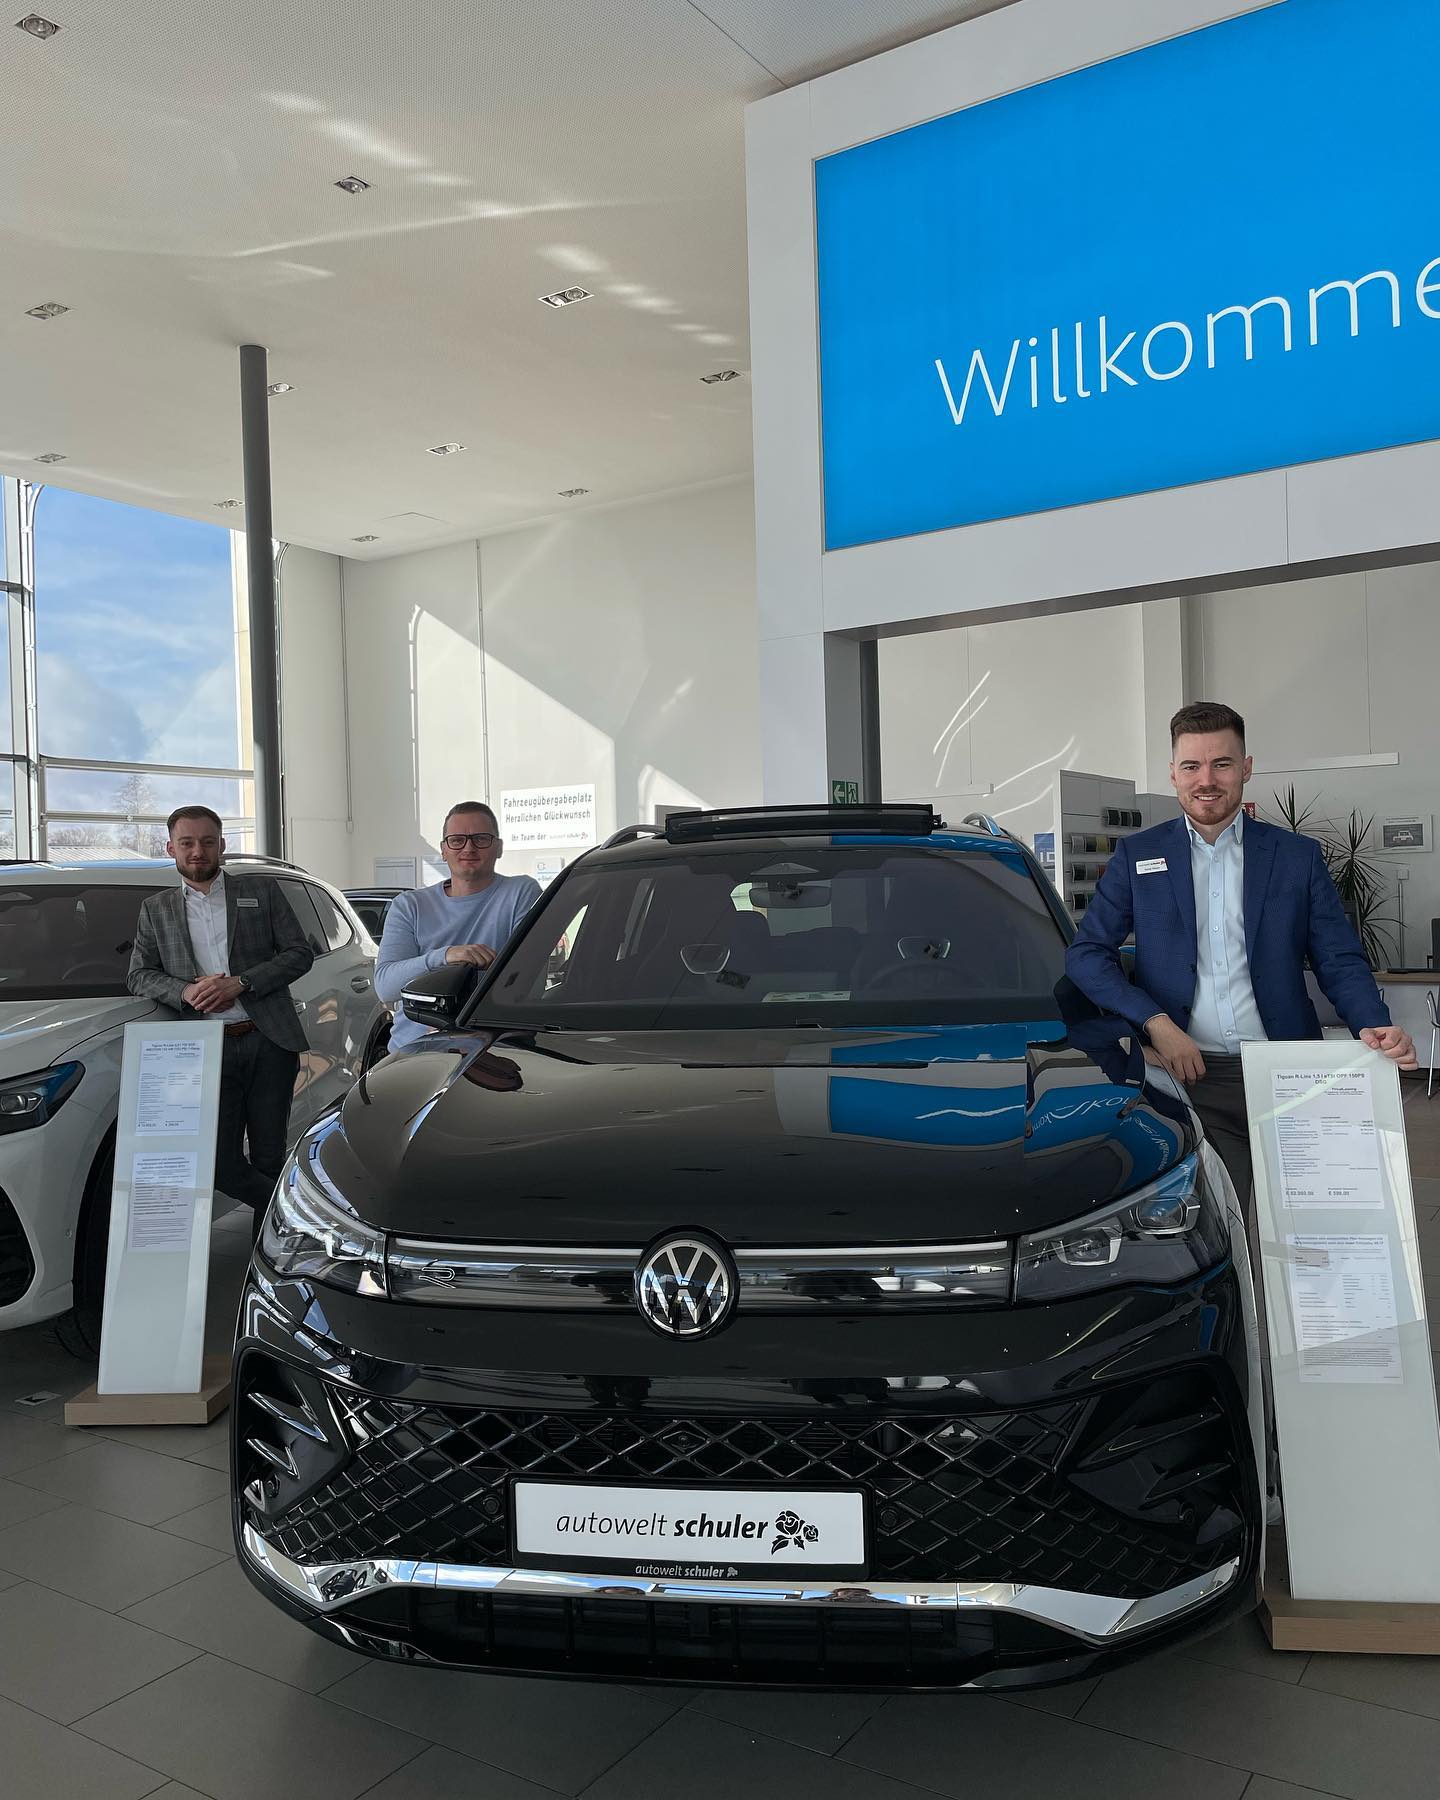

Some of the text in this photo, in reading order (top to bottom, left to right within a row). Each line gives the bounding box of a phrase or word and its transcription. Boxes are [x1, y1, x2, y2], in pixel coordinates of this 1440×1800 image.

[503, 792, 593, 809] Fahrzeugübergabeplatz
[505, 808, 591, 824] Herzlichen Glückwunsch
[511, 833, 519, 841] Ihr
[520, 833, 536, 841] Team
[537, 832, 546, 841] der
[555, 1510, 769, 1540] autowelt schuler
[634, 1563, 725, 1579] autowelt schuler
